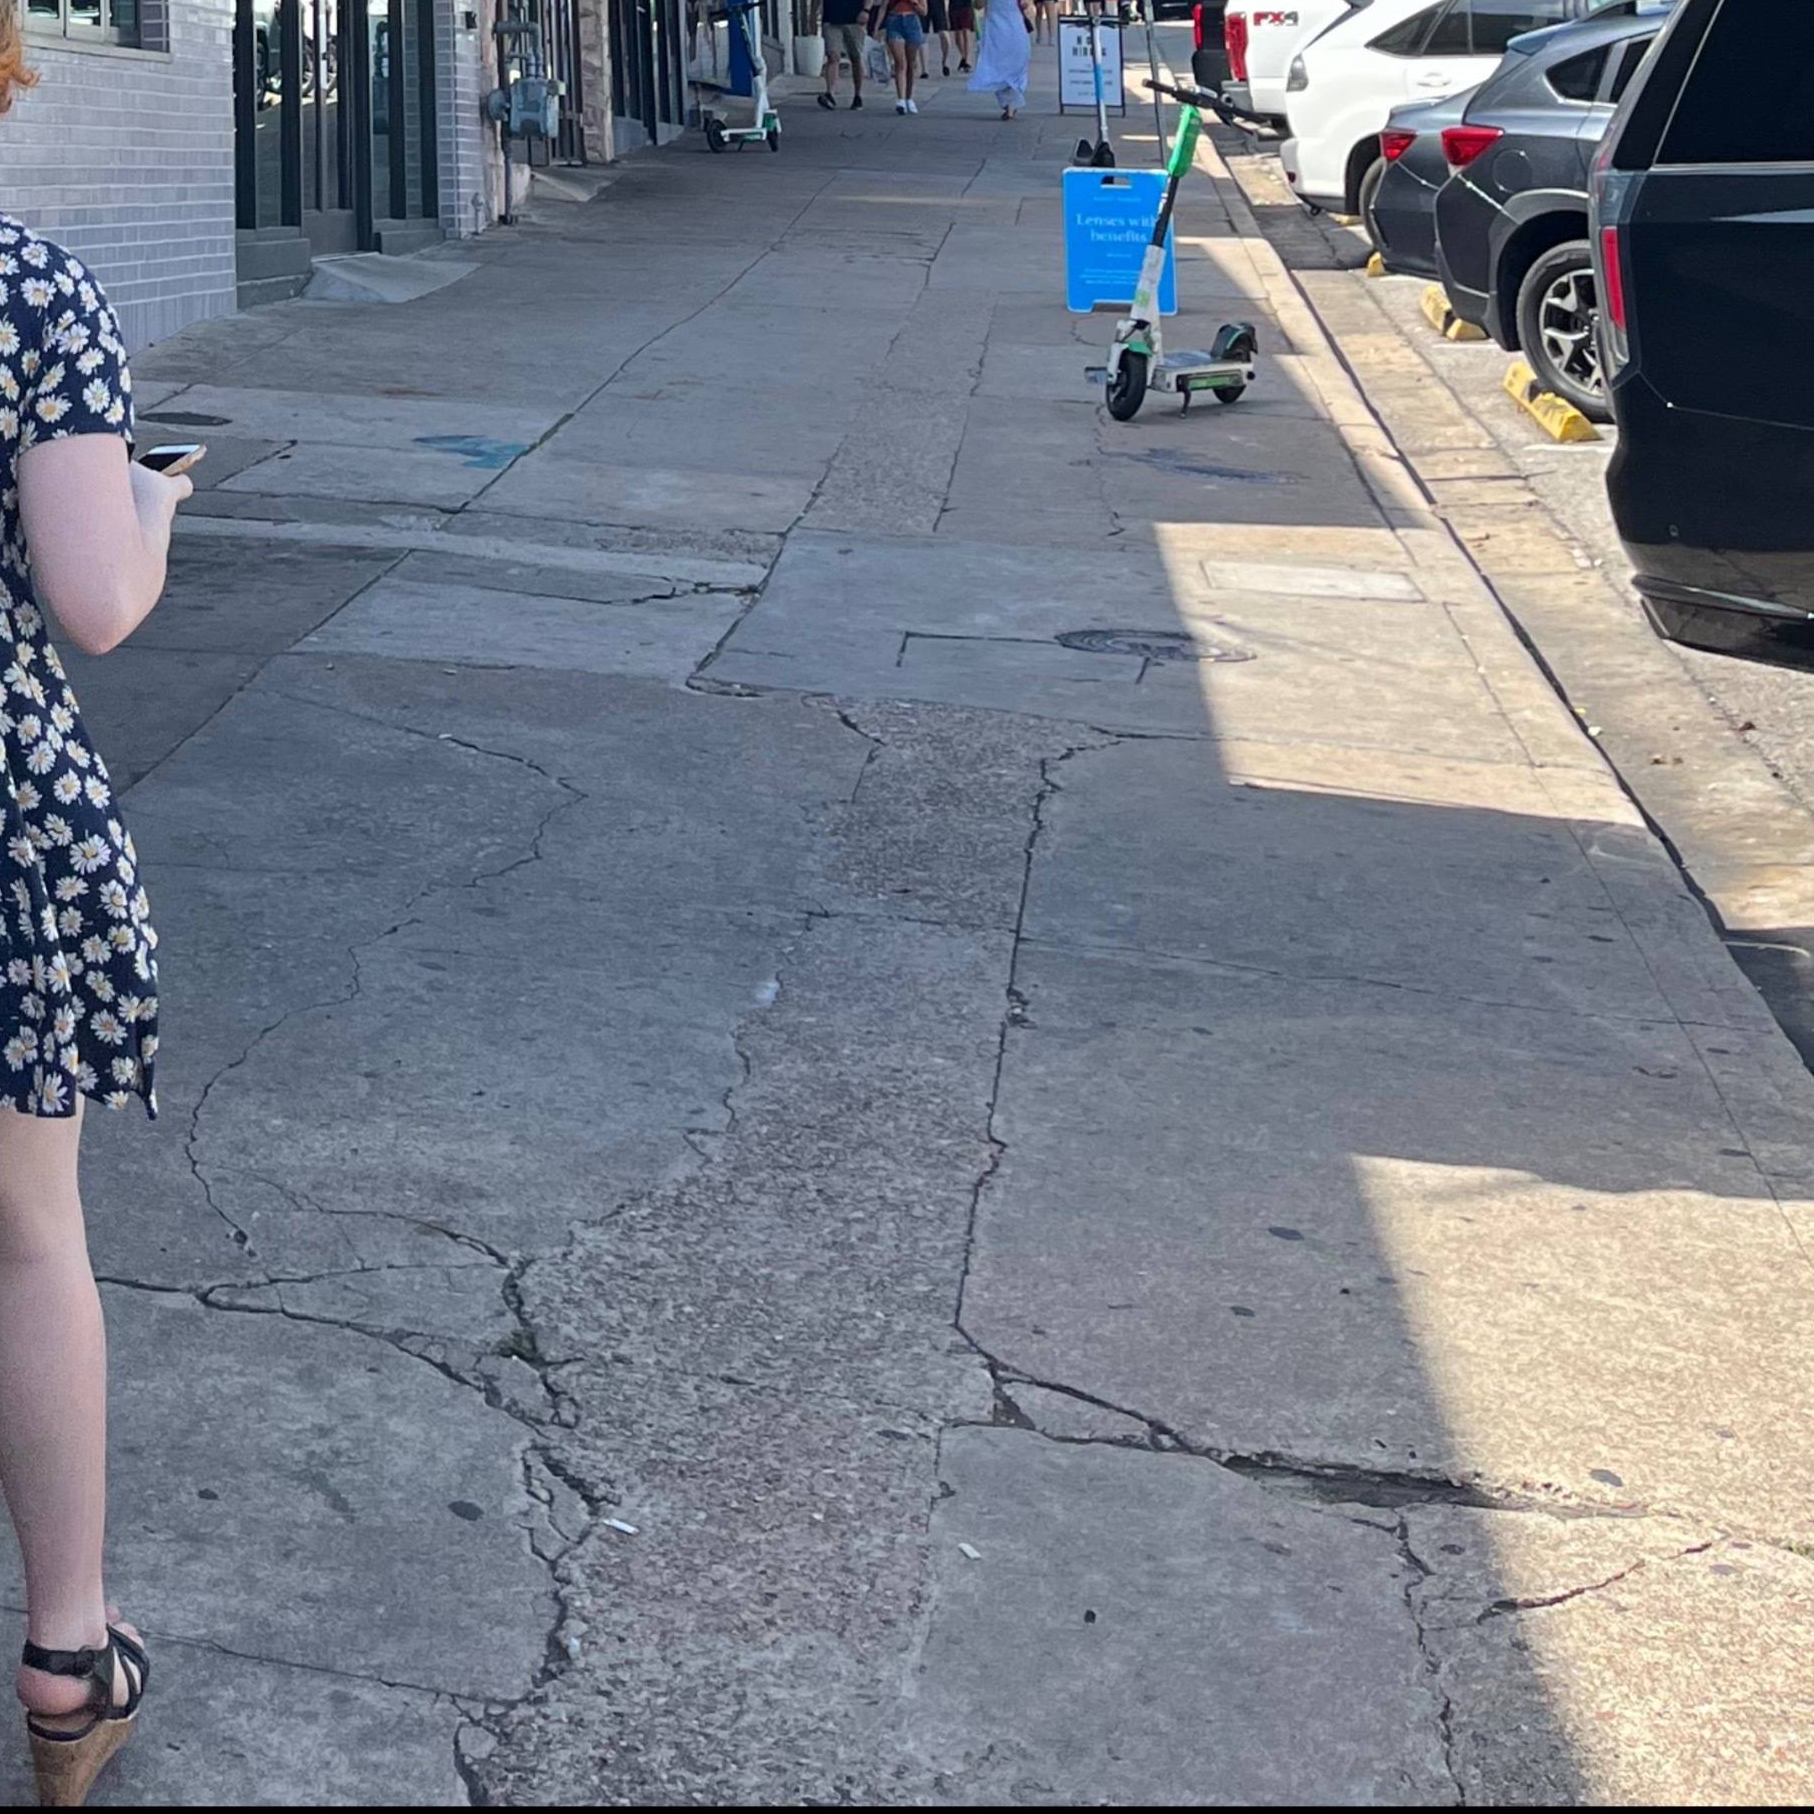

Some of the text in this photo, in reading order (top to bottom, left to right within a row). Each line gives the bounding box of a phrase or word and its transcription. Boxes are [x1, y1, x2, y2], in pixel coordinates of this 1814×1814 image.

[1253, 11, 1299, 27] FX4
[1076, 213, 1126, 227] Lenses
[1090, 228, 1147, 243] benefits
